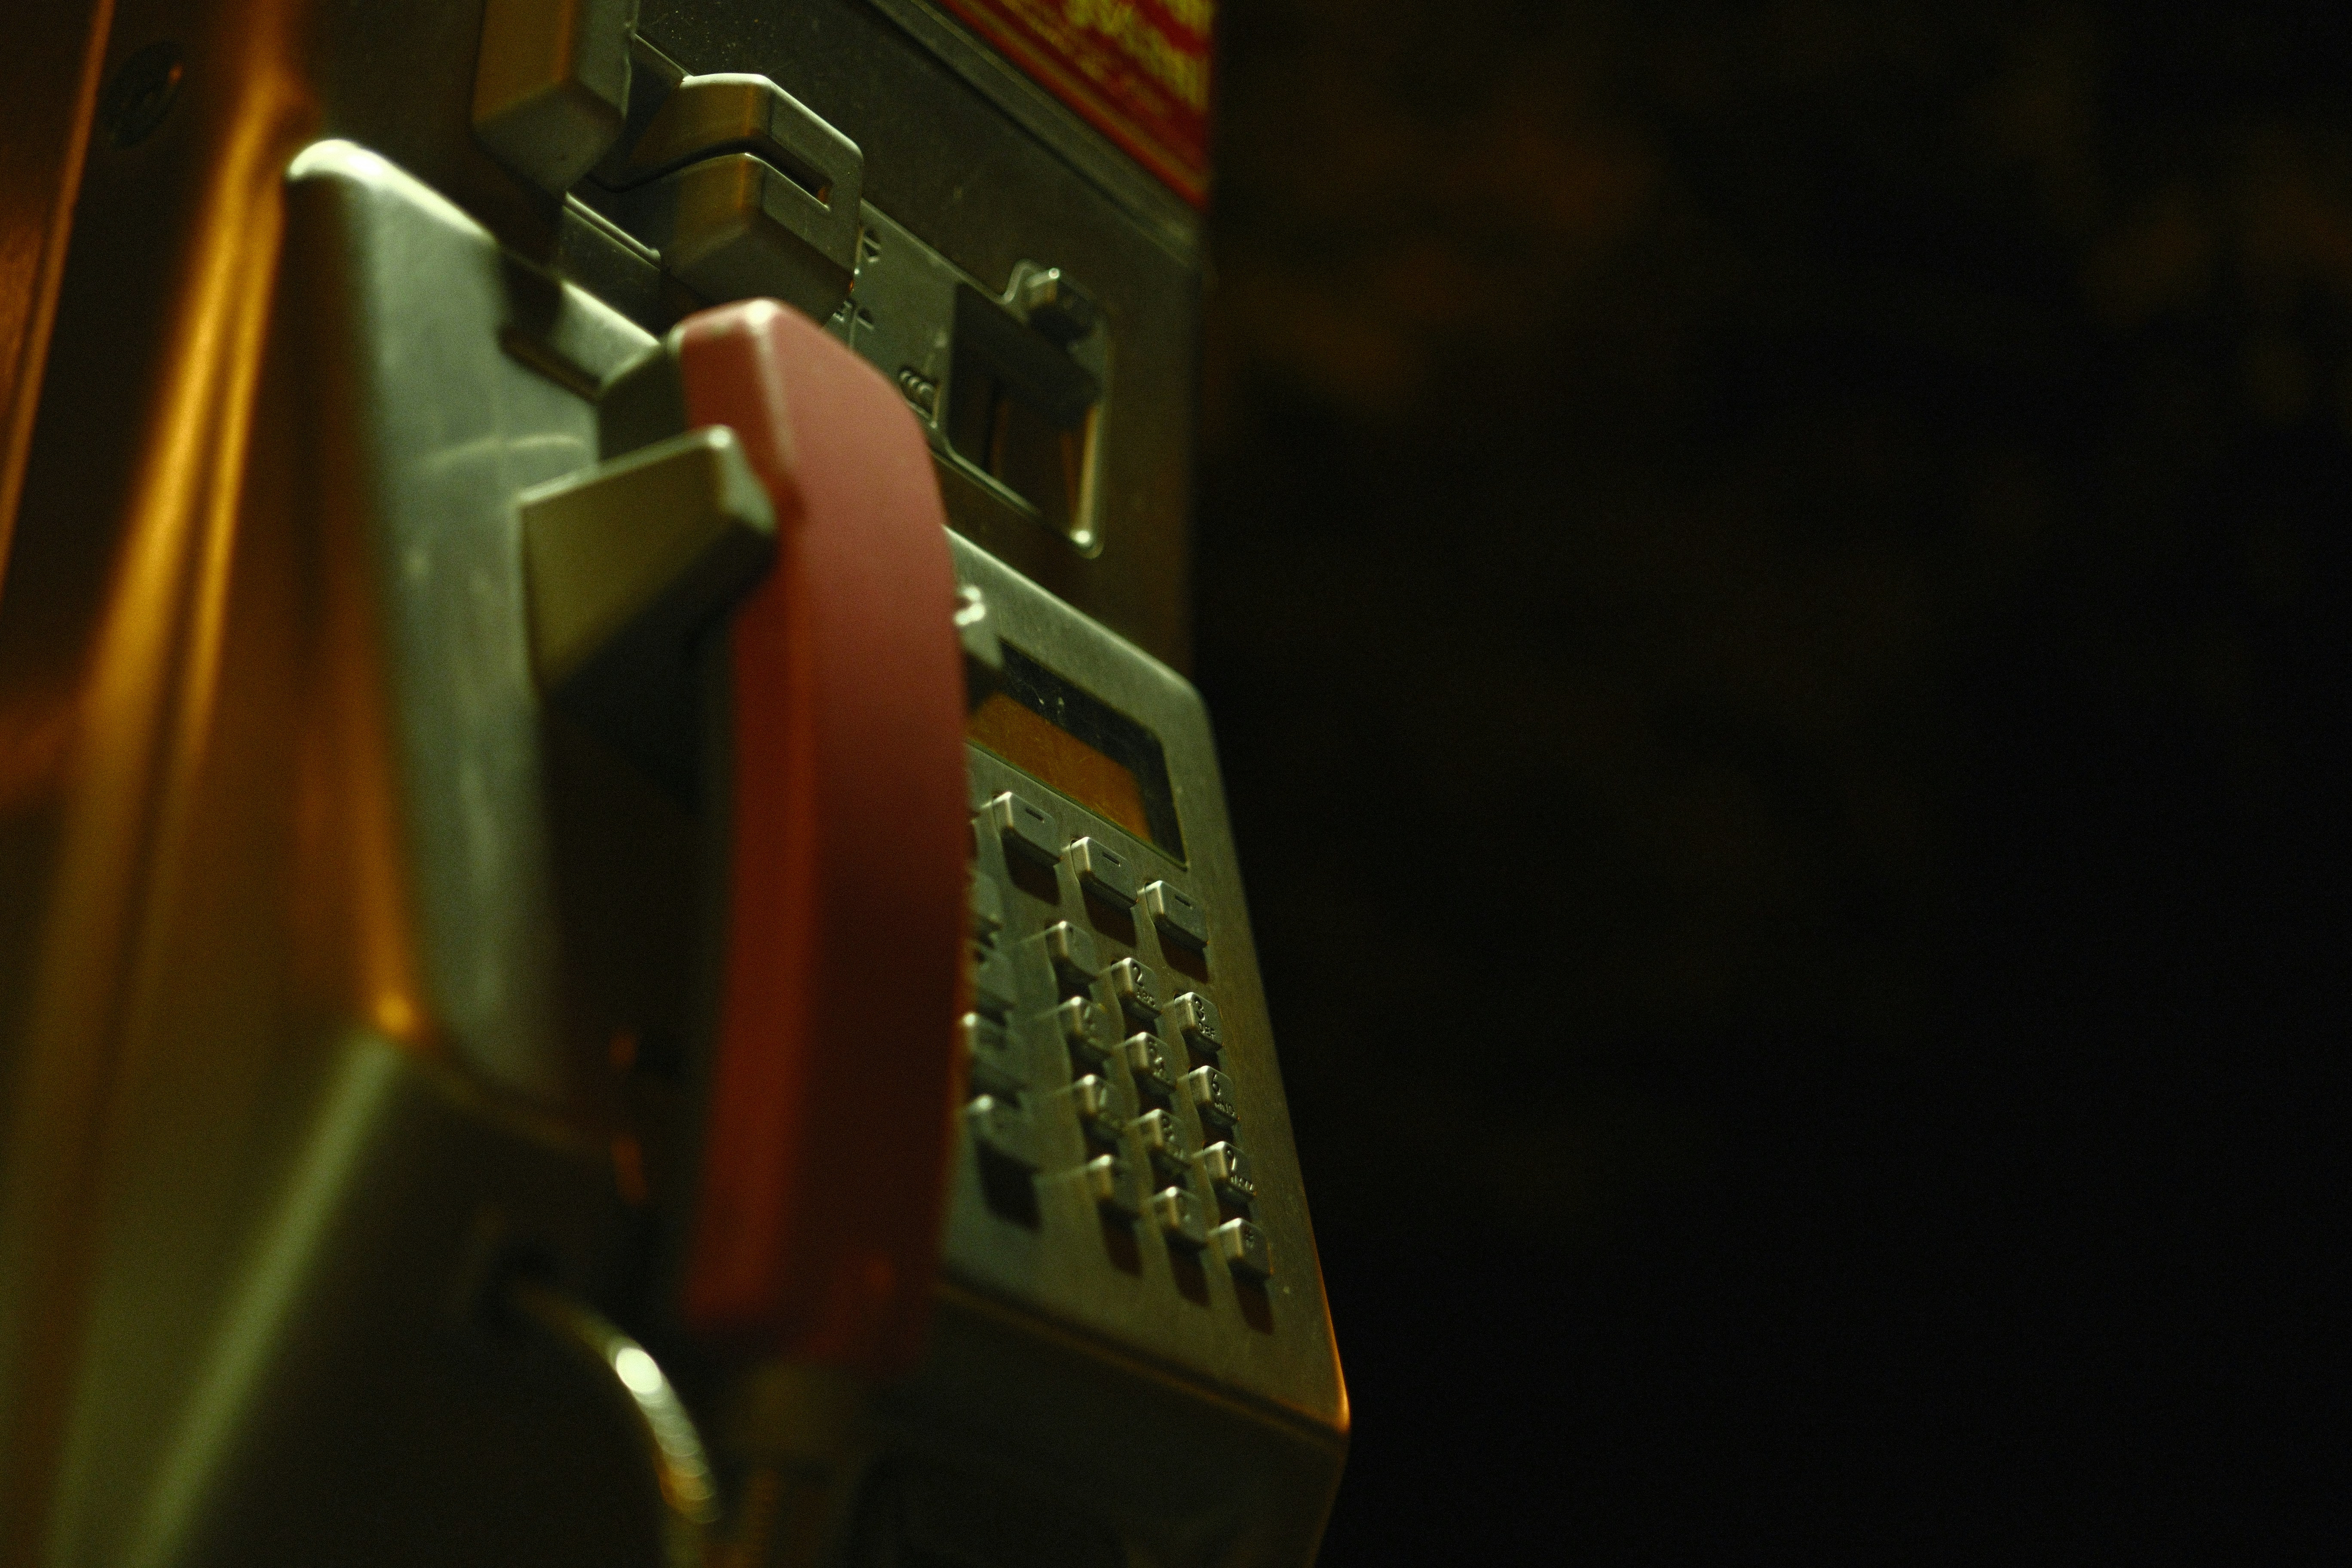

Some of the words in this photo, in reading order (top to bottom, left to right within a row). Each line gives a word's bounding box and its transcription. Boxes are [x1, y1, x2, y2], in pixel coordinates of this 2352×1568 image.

[1194, 996, 1205, 1021] 3
[1206, 1072, 1221, 1096] 6
[1225, 1146, 1236, 1171] 9
